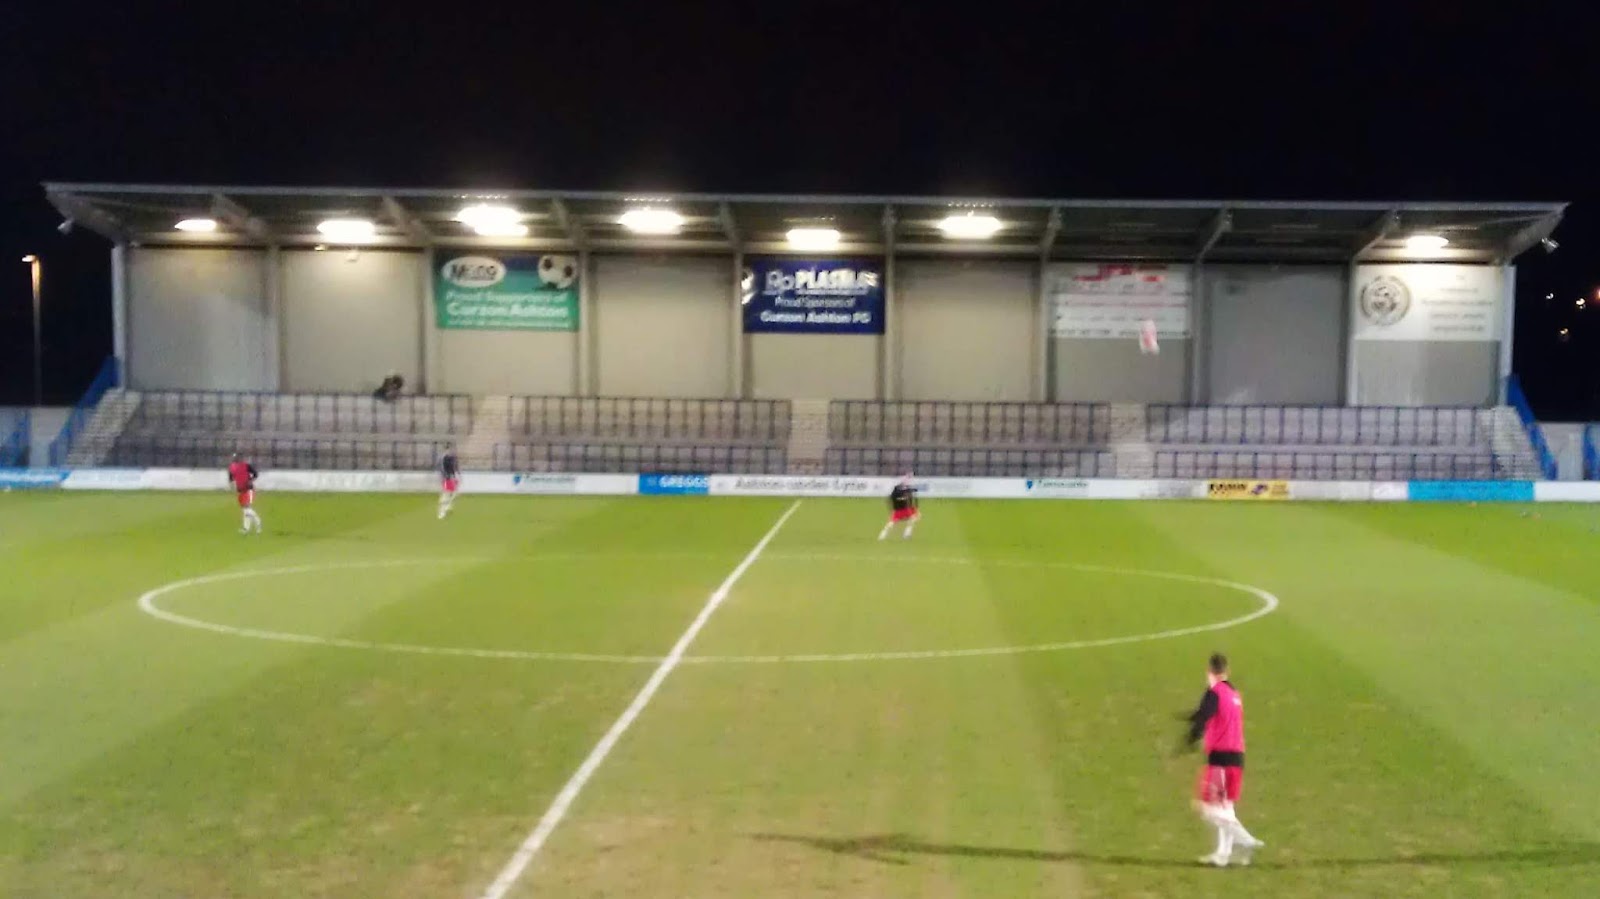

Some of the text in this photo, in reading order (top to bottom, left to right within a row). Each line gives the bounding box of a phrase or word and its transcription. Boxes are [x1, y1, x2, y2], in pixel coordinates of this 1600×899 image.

[510, 303, 569, 318] Ashton
[806, 310, 852, 324] Ashton
[659, 474, 709, 488] GREGGS
